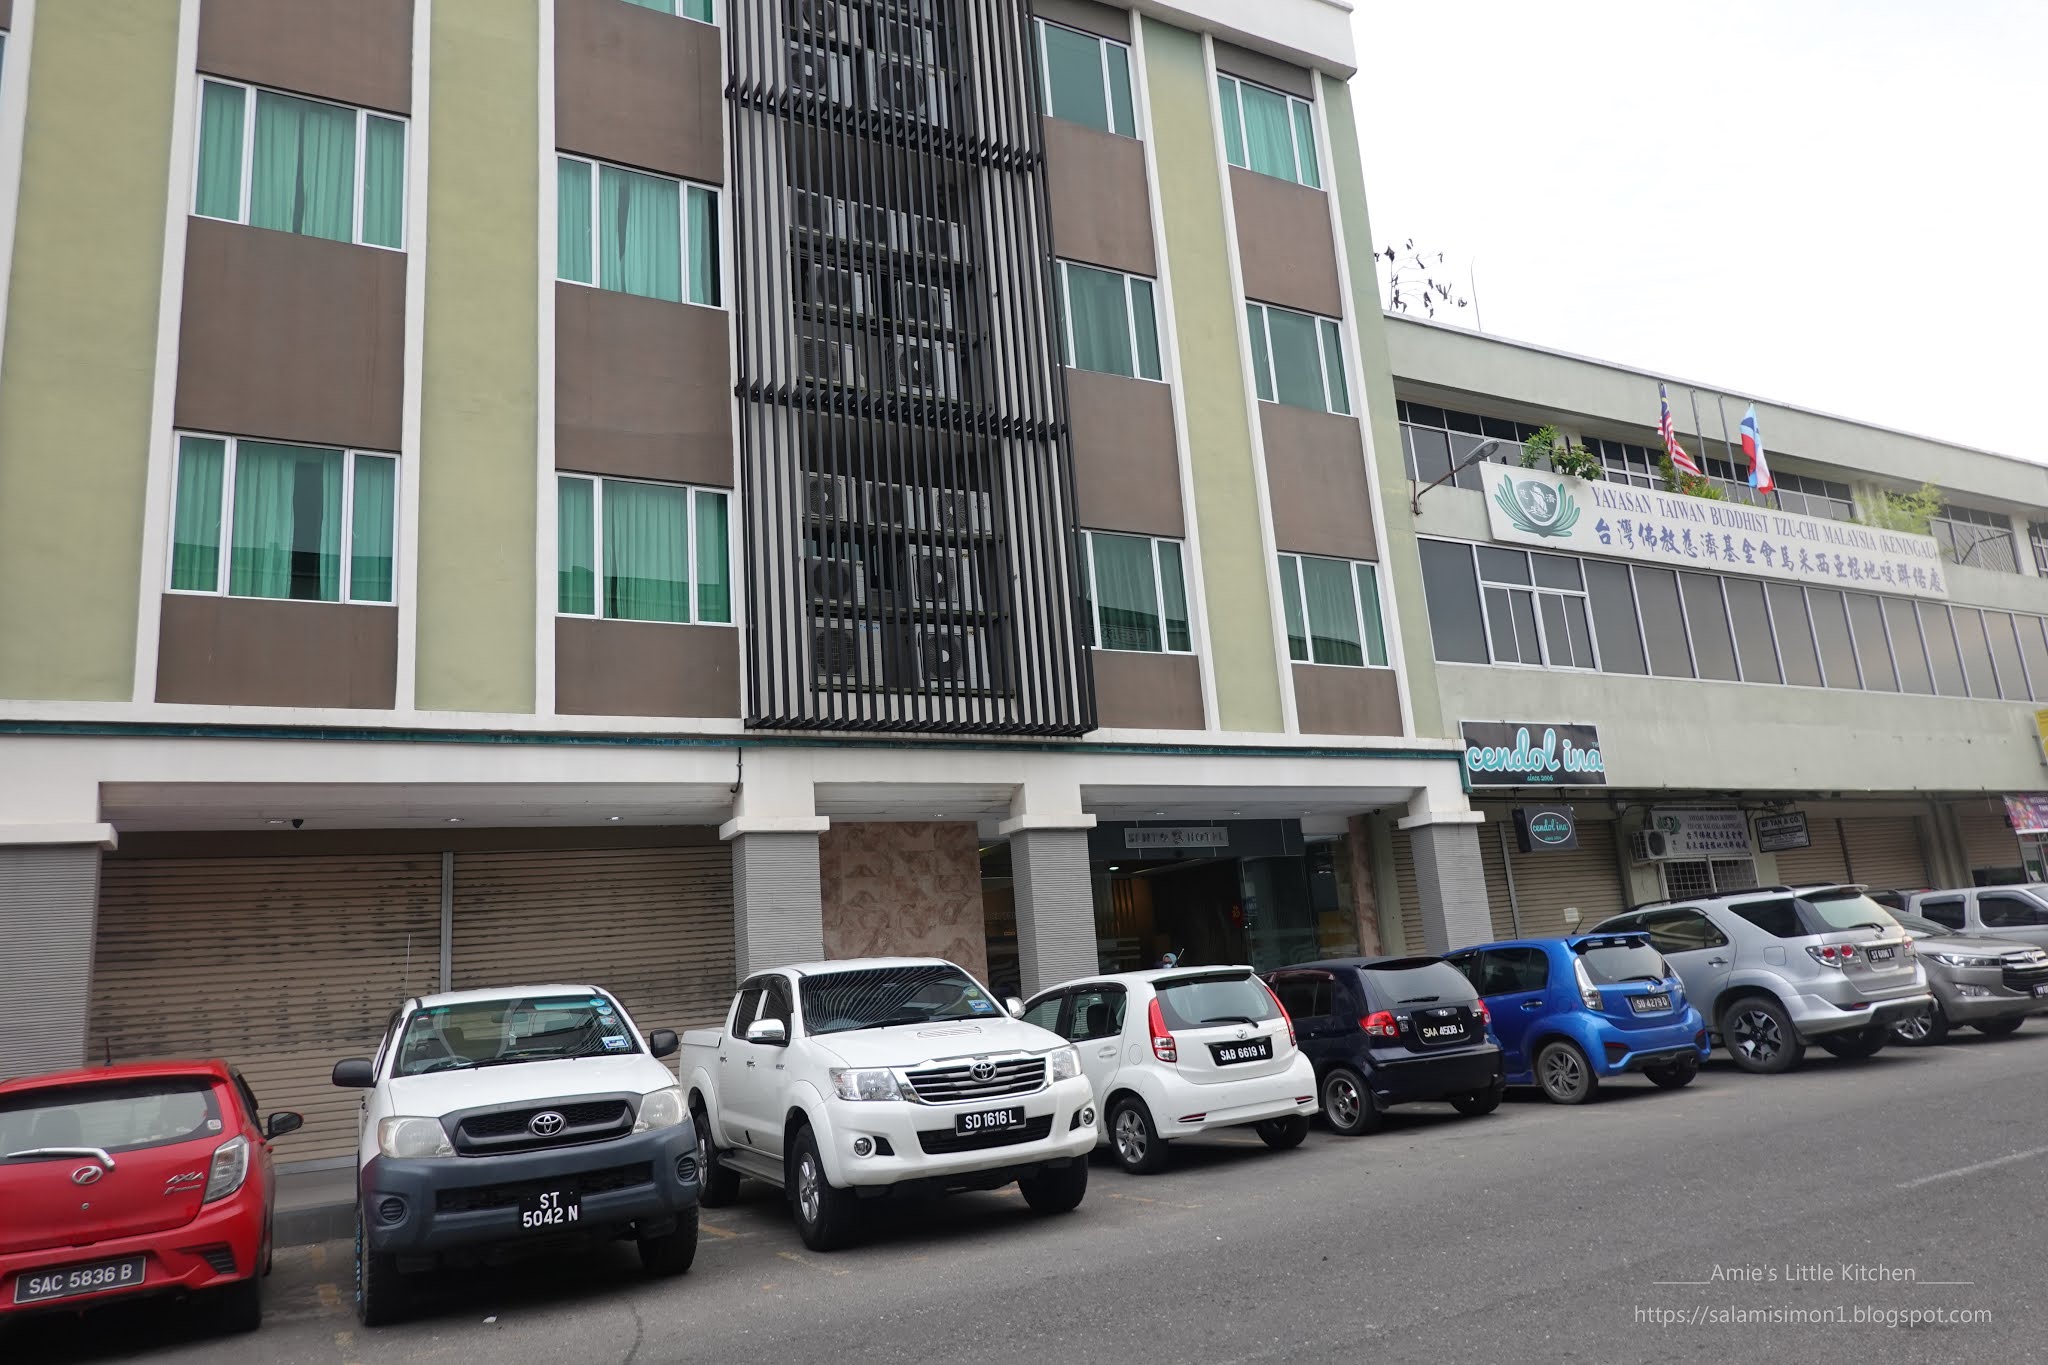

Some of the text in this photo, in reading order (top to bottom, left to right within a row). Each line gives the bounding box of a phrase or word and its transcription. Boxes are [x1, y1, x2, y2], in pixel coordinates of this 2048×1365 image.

[1591, 486, 1937, 559] YAYASAN TAIWAN BUDDHIST TZU-CHI MALAYSIA (KENINGAU)
[1467, 727, 1604, 772] cendol ina
[1532, 818, 1568, 832] cendol ina
[1770, 818, 1782, 827] TAN
[1187, 830, 1224, 842] HOTEL
[1646, 998, 1662, 1008] 4279
[1423, 1027, 1439, 1037] SAA
[1458, 1024, 1464, 1033] J
[1220, 1045, 1266, 1061] SAB 6619 H
[965, 1109, 1017, 1129] SD 1616 L
[540, 1191, 560, 1209] ST
[523, 1204, 578, 1228] 5042 N
[29, 1263, 133, 1295] SAC 5836 B
